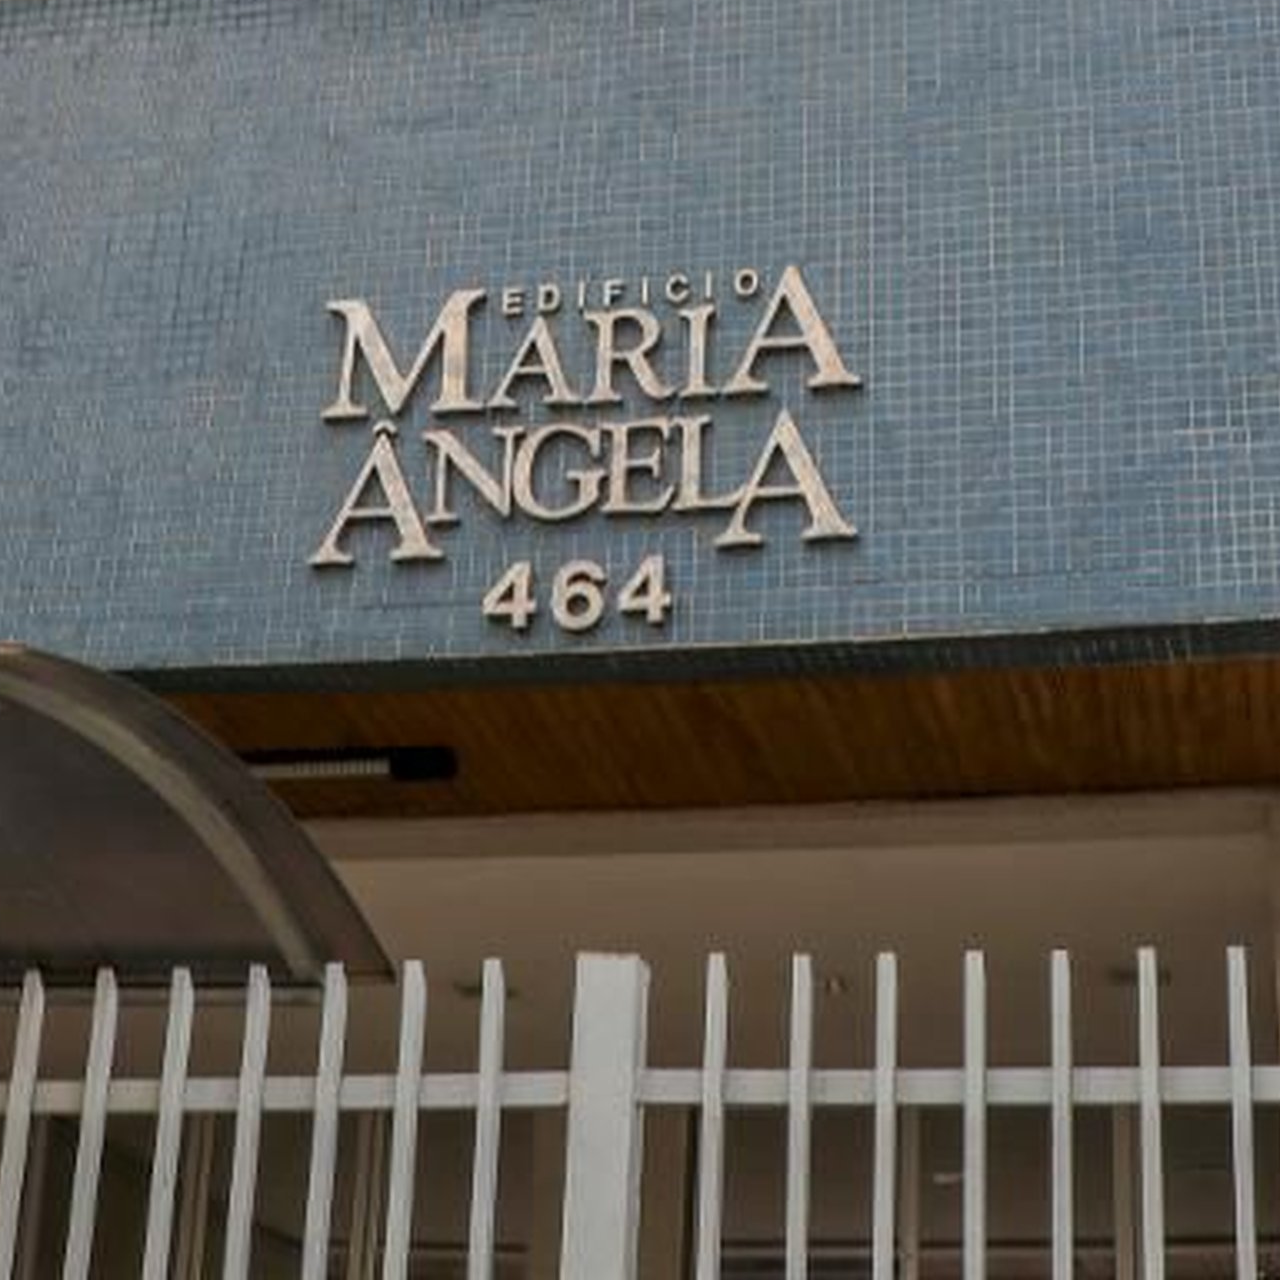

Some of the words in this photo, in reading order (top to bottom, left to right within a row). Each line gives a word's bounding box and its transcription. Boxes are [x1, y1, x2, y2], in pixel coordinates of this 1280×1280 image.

[322, 265, 863, 420] MARIA
[502, 268, 760, 315] EDIFICIO
[308, 408, 858, 567] ÂNGELA
[481, 554, 672, 631] 464
